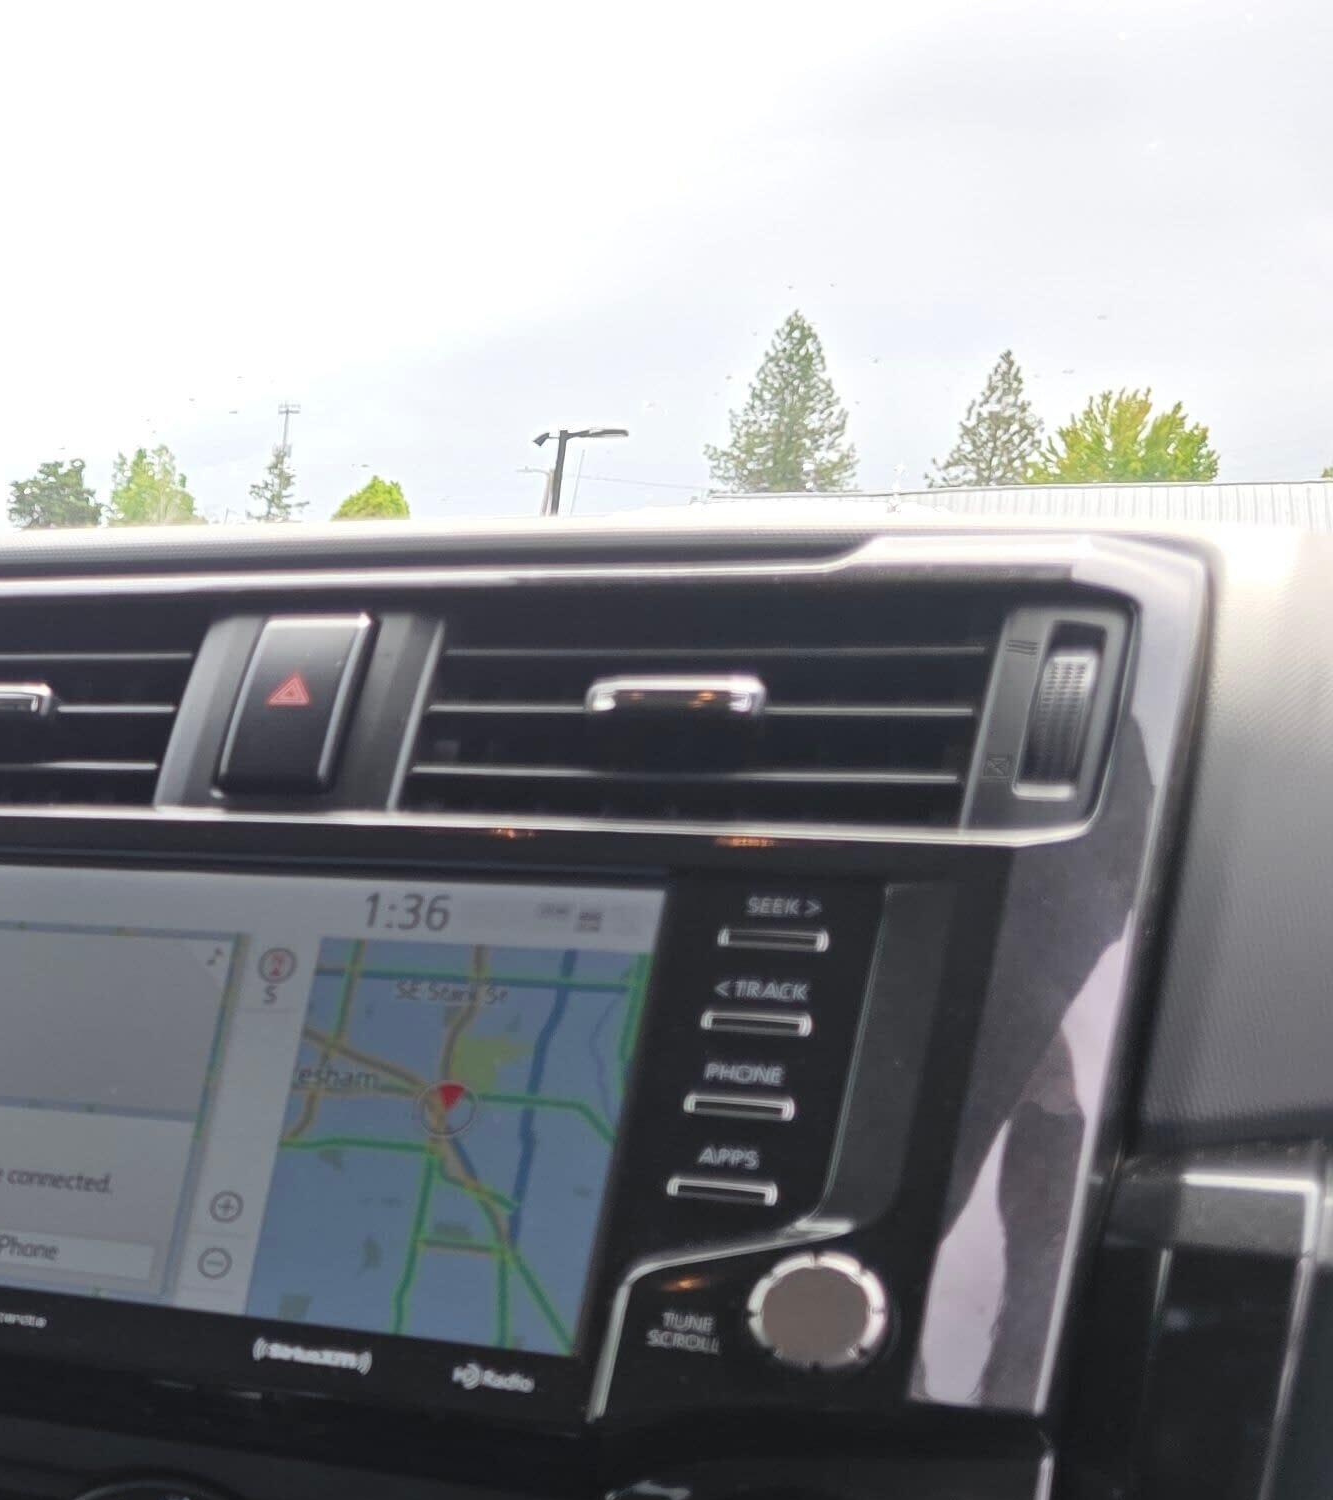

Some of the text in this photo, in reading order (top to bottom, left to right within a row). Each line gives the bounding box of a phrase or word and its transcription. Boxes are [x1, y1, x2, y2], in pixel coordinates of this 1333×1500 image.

[365, 891, 451, 932] 1:36
[746, 896, 800, 916] SEEK
[734, 980, 811, 1001] TRACK
[704, 1063, 785, 1085] PHONE
[697, 1147, 761, 1170] APPS
[7, 1165, 114, 1195] connected.
[663, 1309, 716, 1333] TUNE
[645, 1328, 721, 1356] SCROLL
